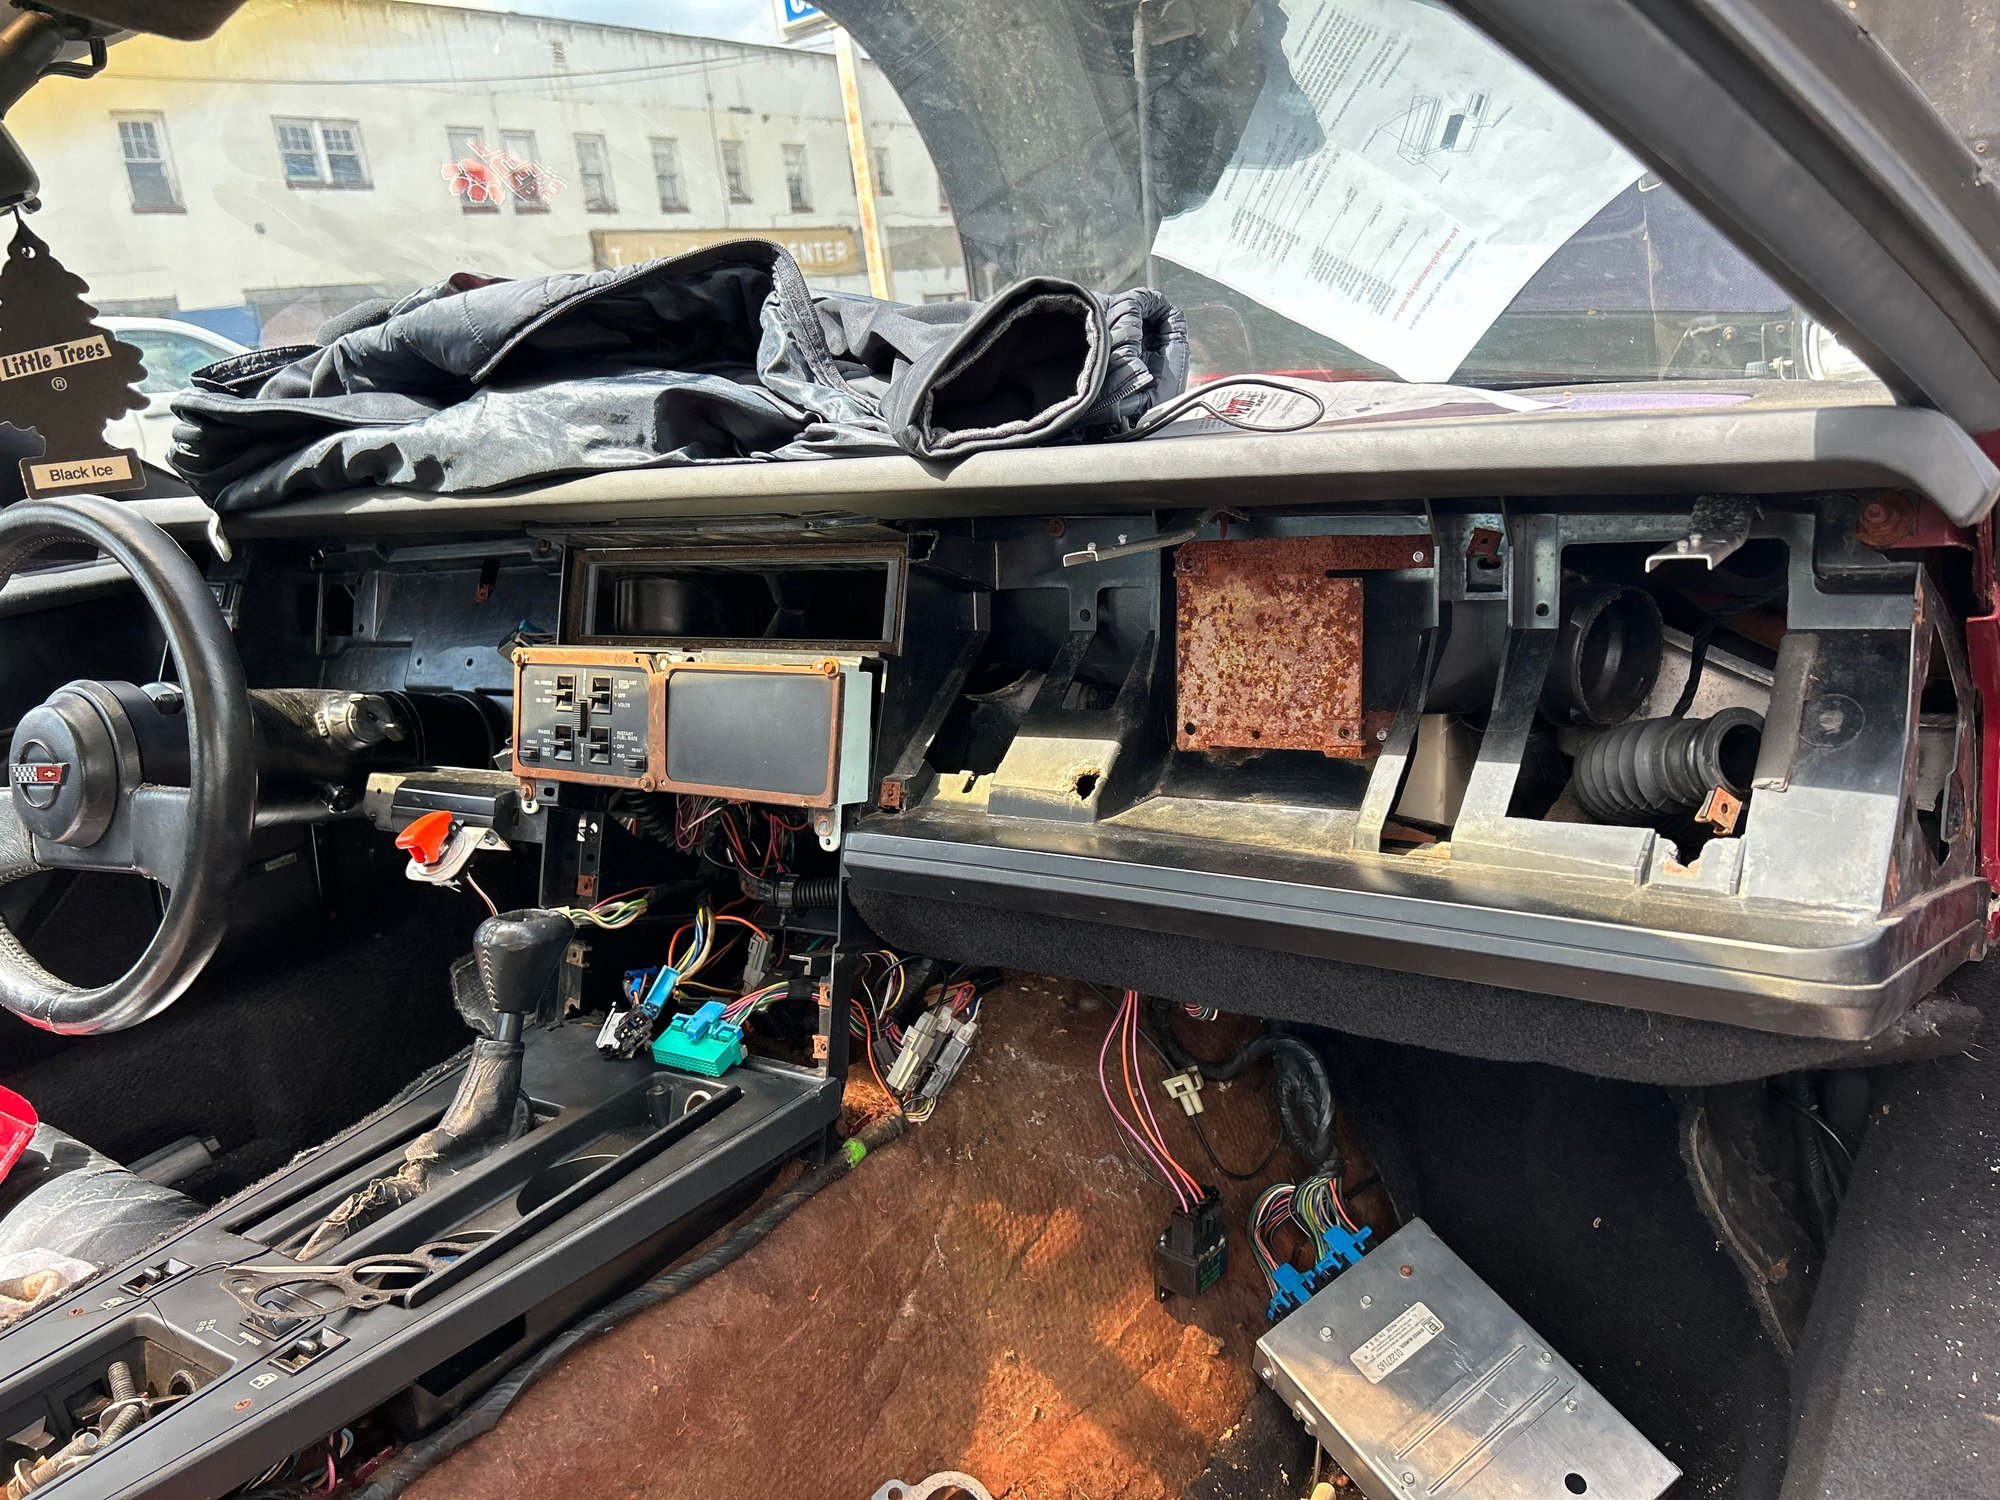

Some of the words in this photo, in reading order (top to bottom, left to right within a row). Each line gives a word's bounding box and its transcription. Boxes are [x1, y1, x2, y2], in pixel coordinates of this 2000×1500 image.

[787, 241, 848, 264] ENTER
[2, 351, 52, 378] Little
[54, 343, 105, 365] Trees
[50, 466, 90, 482] Black
[93, 464, 113, 477] Ice
[1386, 1323, 1396, 1333] MADE
[1376, 1348, 1403, 1372] 01227165
